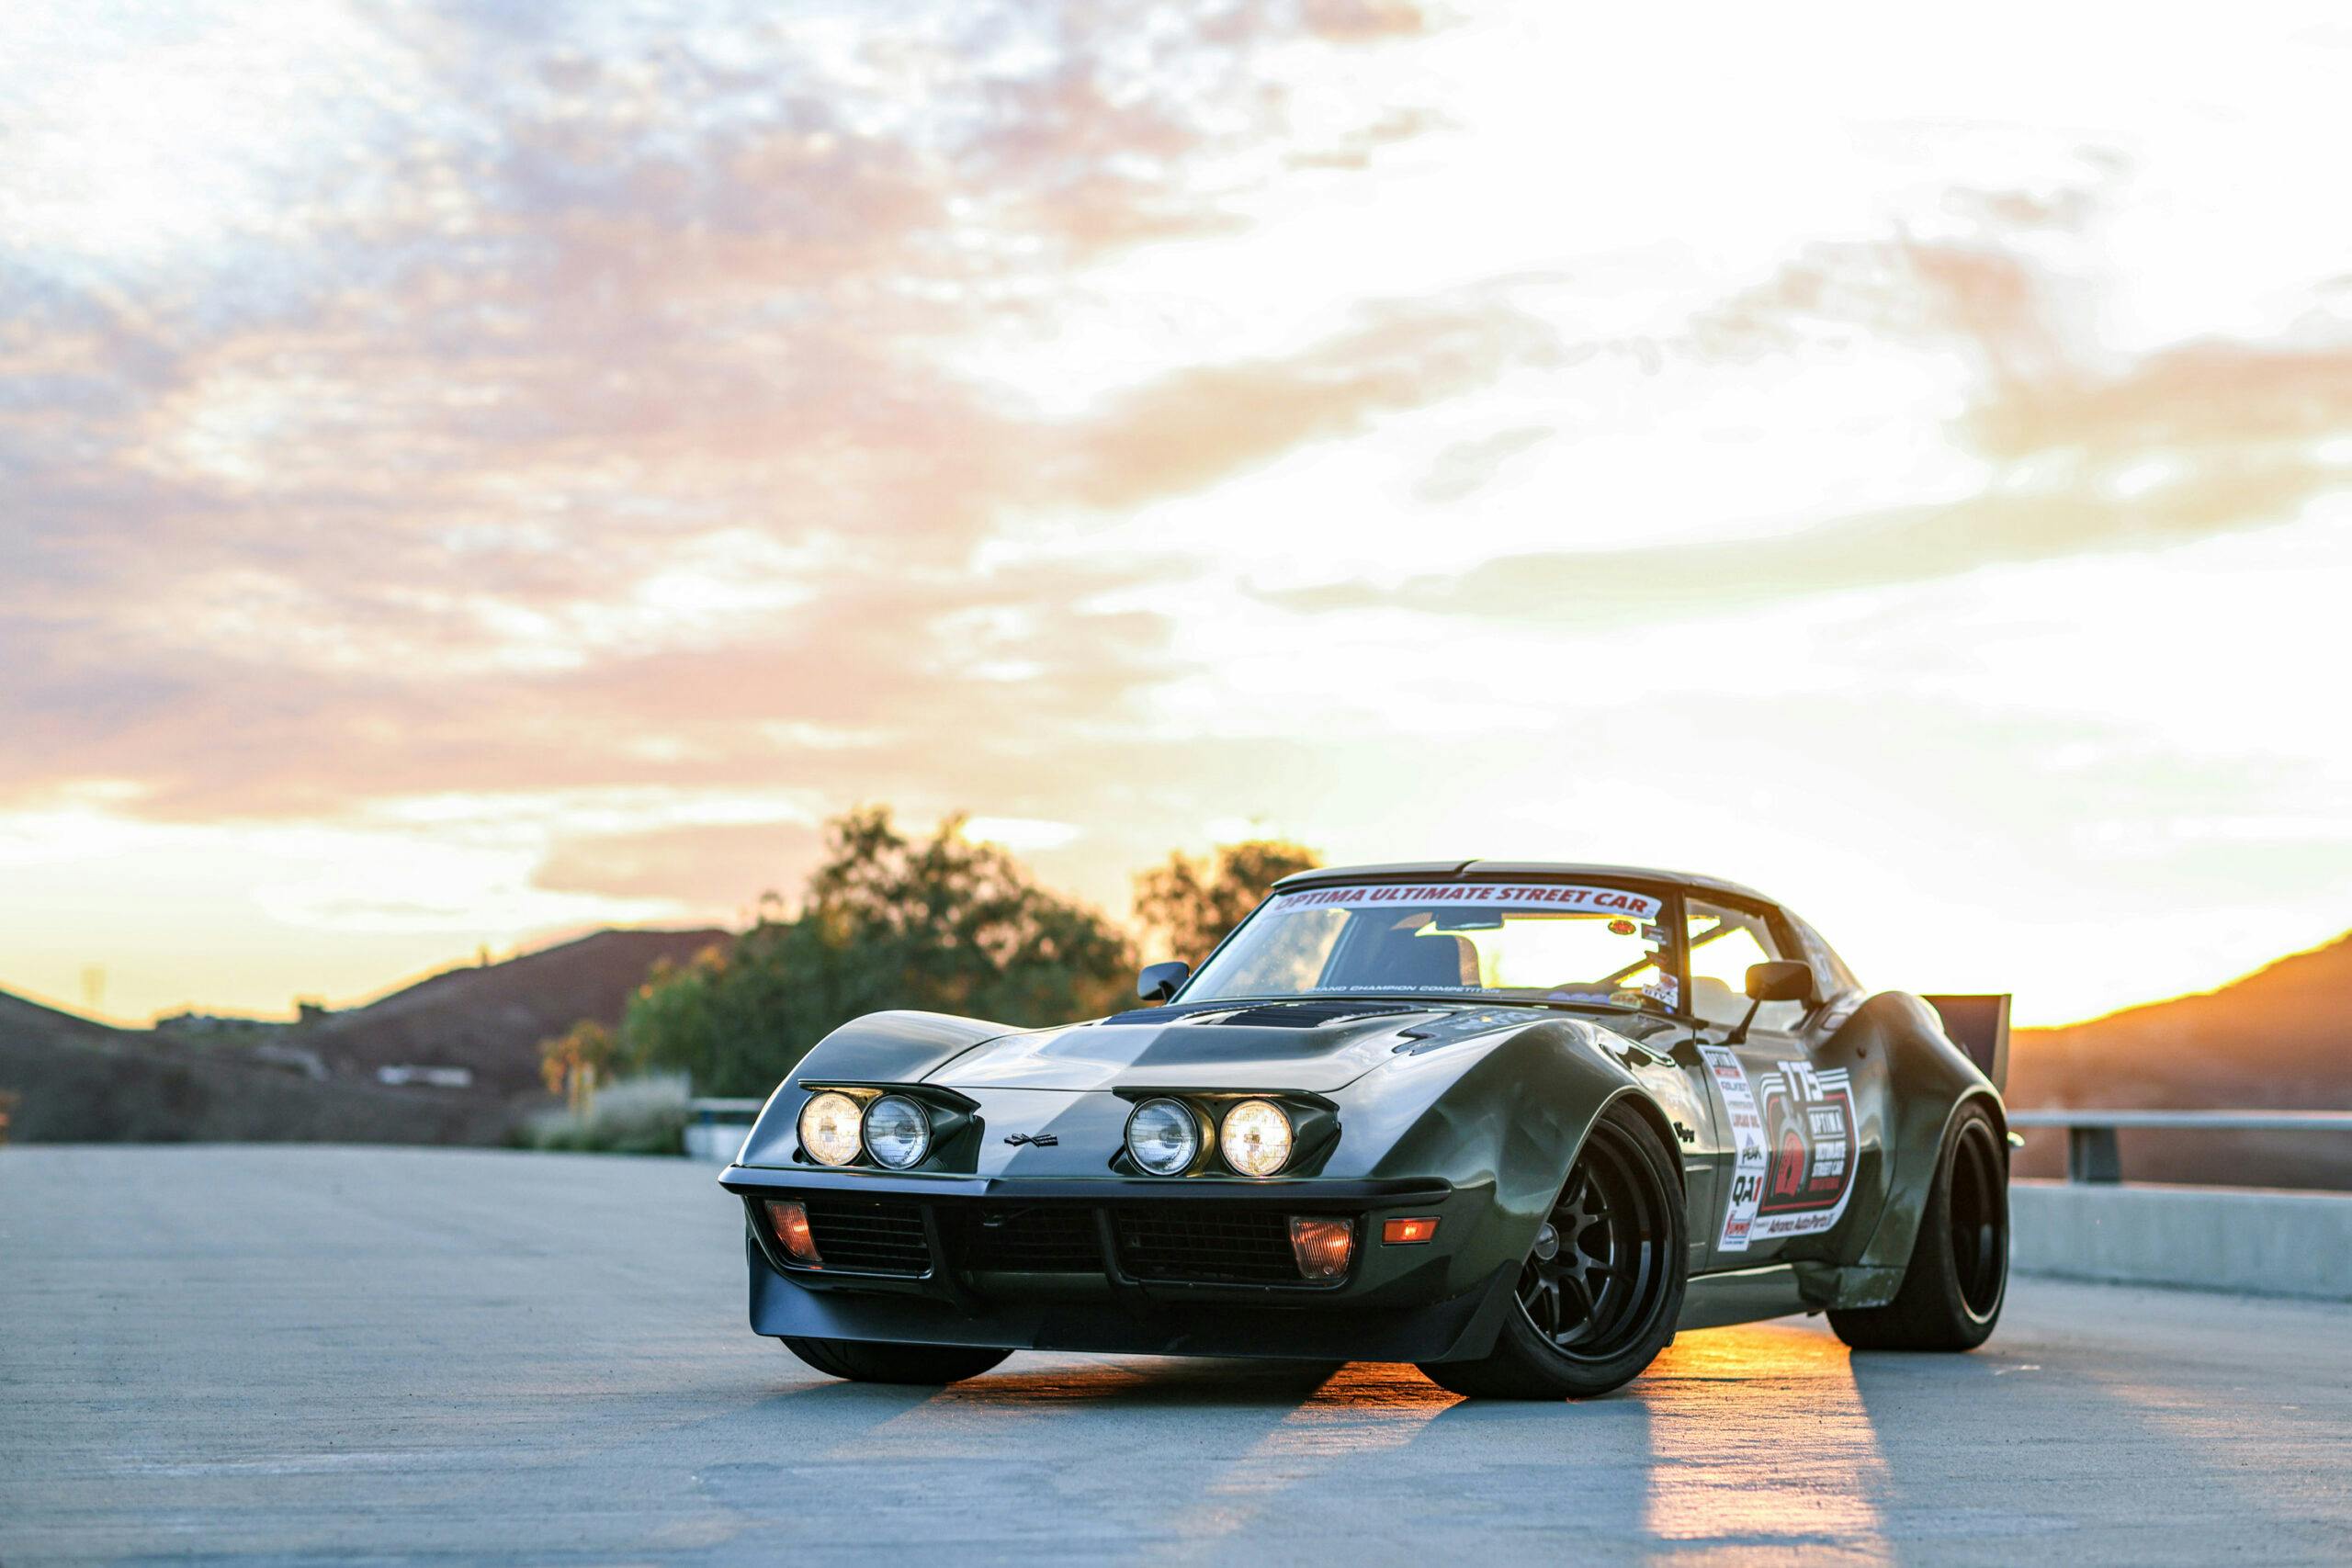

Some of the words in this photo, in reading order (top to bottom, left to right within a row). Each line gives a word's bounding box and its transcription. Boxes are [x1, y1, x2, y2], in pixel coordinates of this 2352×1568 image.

[1274, 889, 1367, 910] OPTIMA
[1369, 887, 1498, 901] ULTIMATE
[1496, 887, 1592, 903] STREET
[1593, 893, 1648, 913] CAR
[1777, 1061, 1824, 1101] 775
[1809, 1111, 1844, 1134] OPTIMA
[1732, 1176, 1763, 1207] QA1
